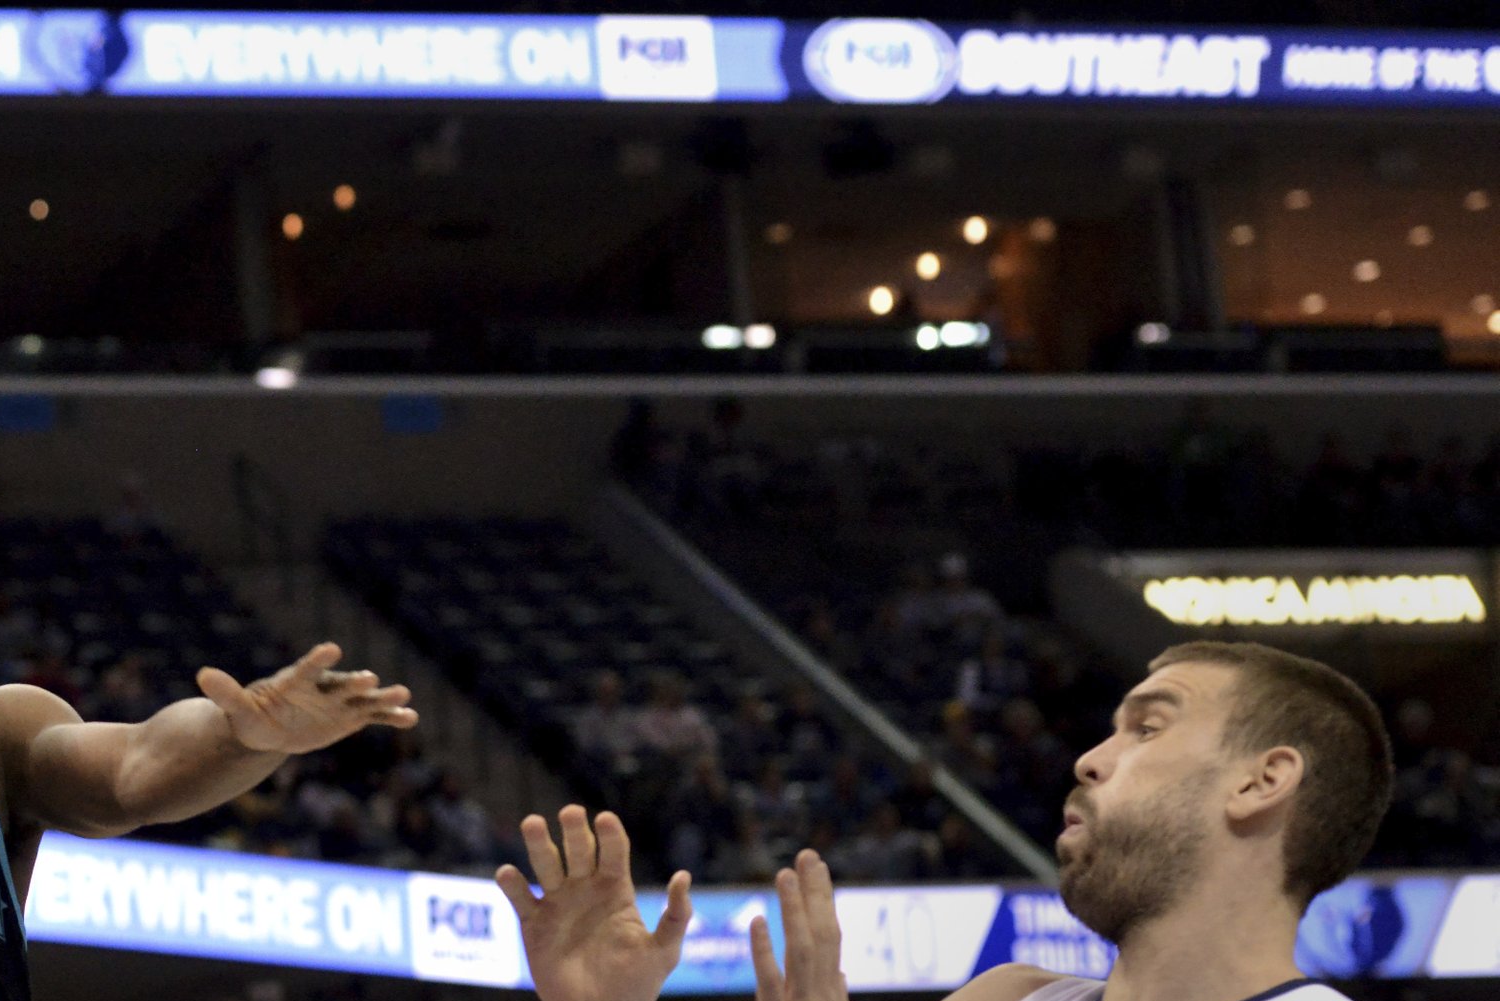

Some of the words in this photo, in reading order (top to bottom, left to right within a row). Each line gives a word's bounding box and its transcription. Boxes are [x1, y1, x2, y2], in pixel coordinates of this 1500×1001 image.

[142, 23, 500, 85] EVERYWHERE
[508, 26, 593, 84] ON
[958, 28, 1270, 97] SOUTHEAST
[25, 848, 323, 948] ERYWHERE
[326, 885, 404, 956] ON
